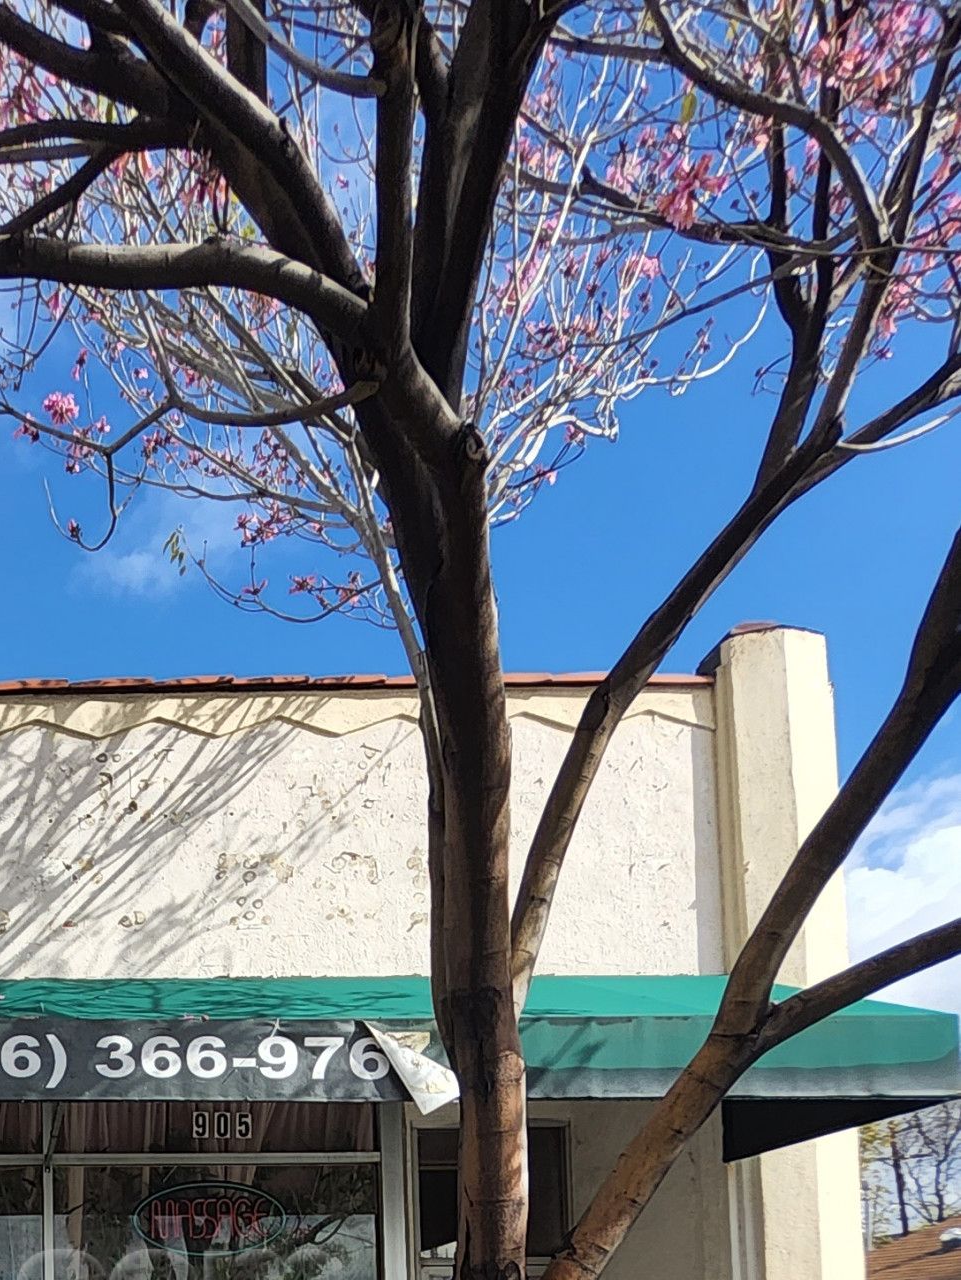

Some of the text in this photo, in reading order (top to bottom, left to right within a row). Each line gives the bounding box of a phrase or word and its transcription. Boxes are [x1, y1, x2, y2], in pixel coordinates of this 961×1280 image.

[95, 1035, 391, 1080] 366-976
[194, 1112, 250, 1138] 905
[151, 1198, 270, 1239] MASSAGE
